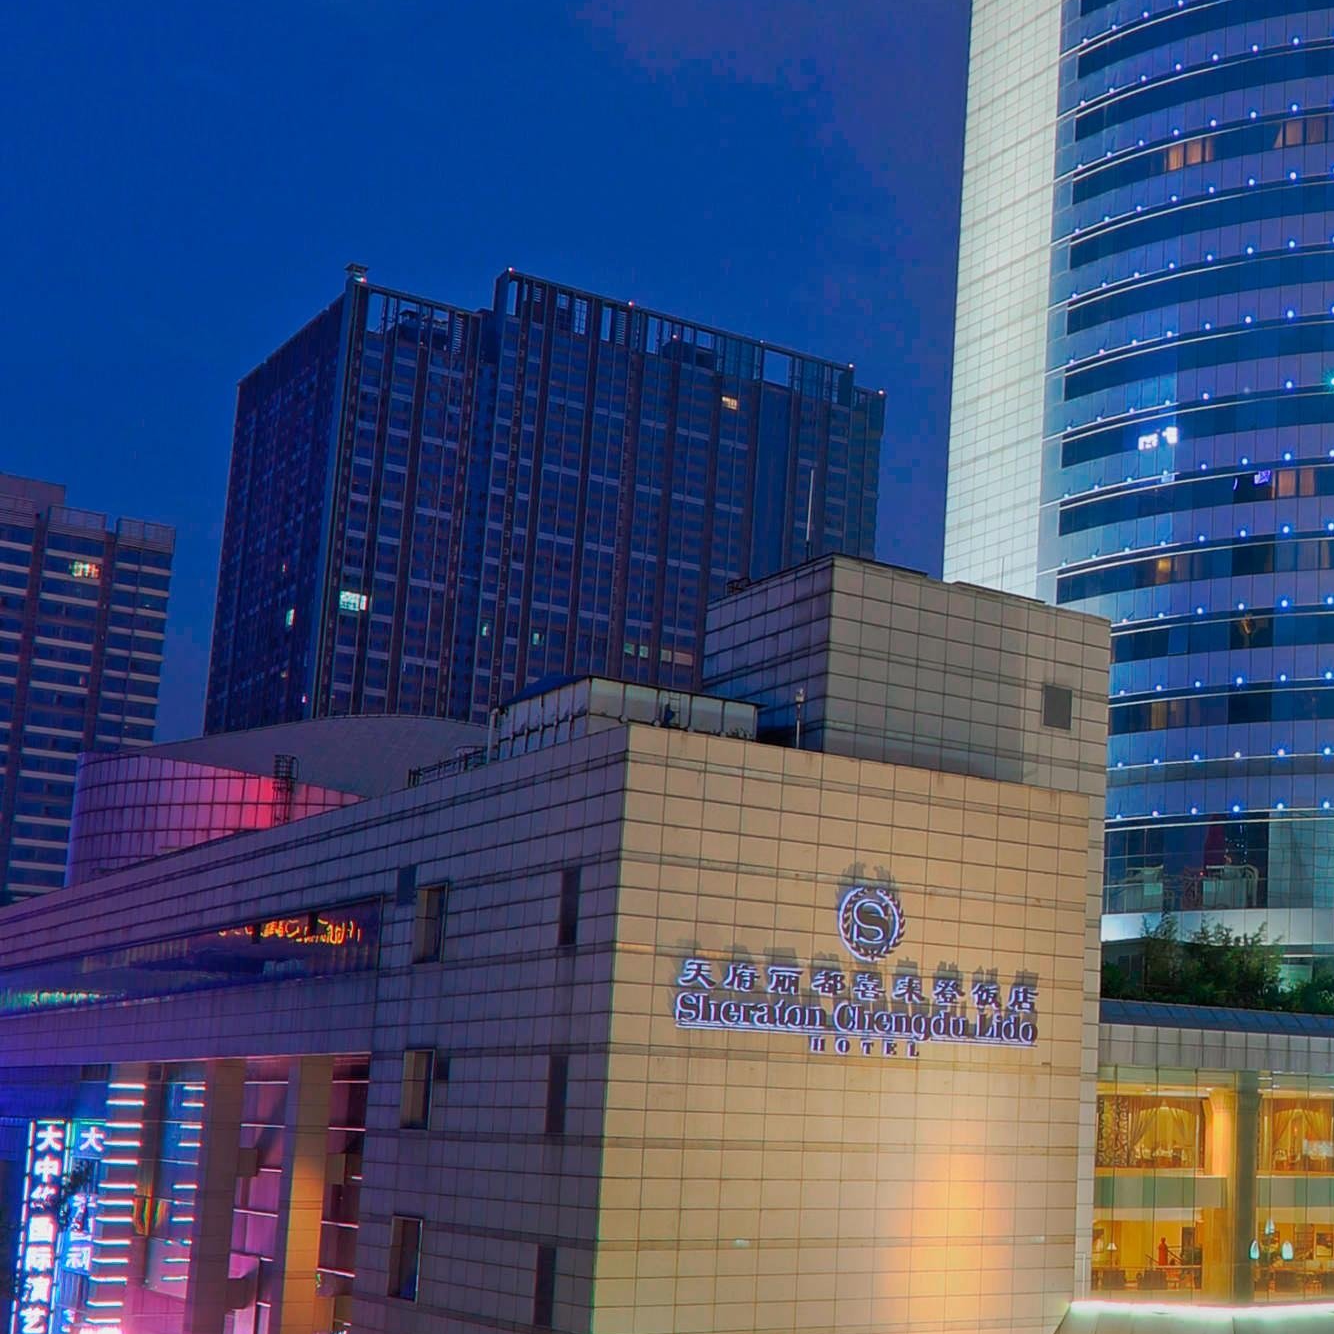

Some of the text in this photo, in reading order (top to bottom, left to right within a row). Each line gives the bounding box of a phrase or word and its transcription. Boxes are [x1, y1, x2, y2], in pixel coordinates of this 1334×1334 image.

[853, 898, 890, 944] S
[678, 959, 1039, 1013] 天府丽都喜来登饭店
[675, 991, 1039, 1044] Sheraton Chengdu Lido
[811, 1036, 920, 1059] HOTEL
